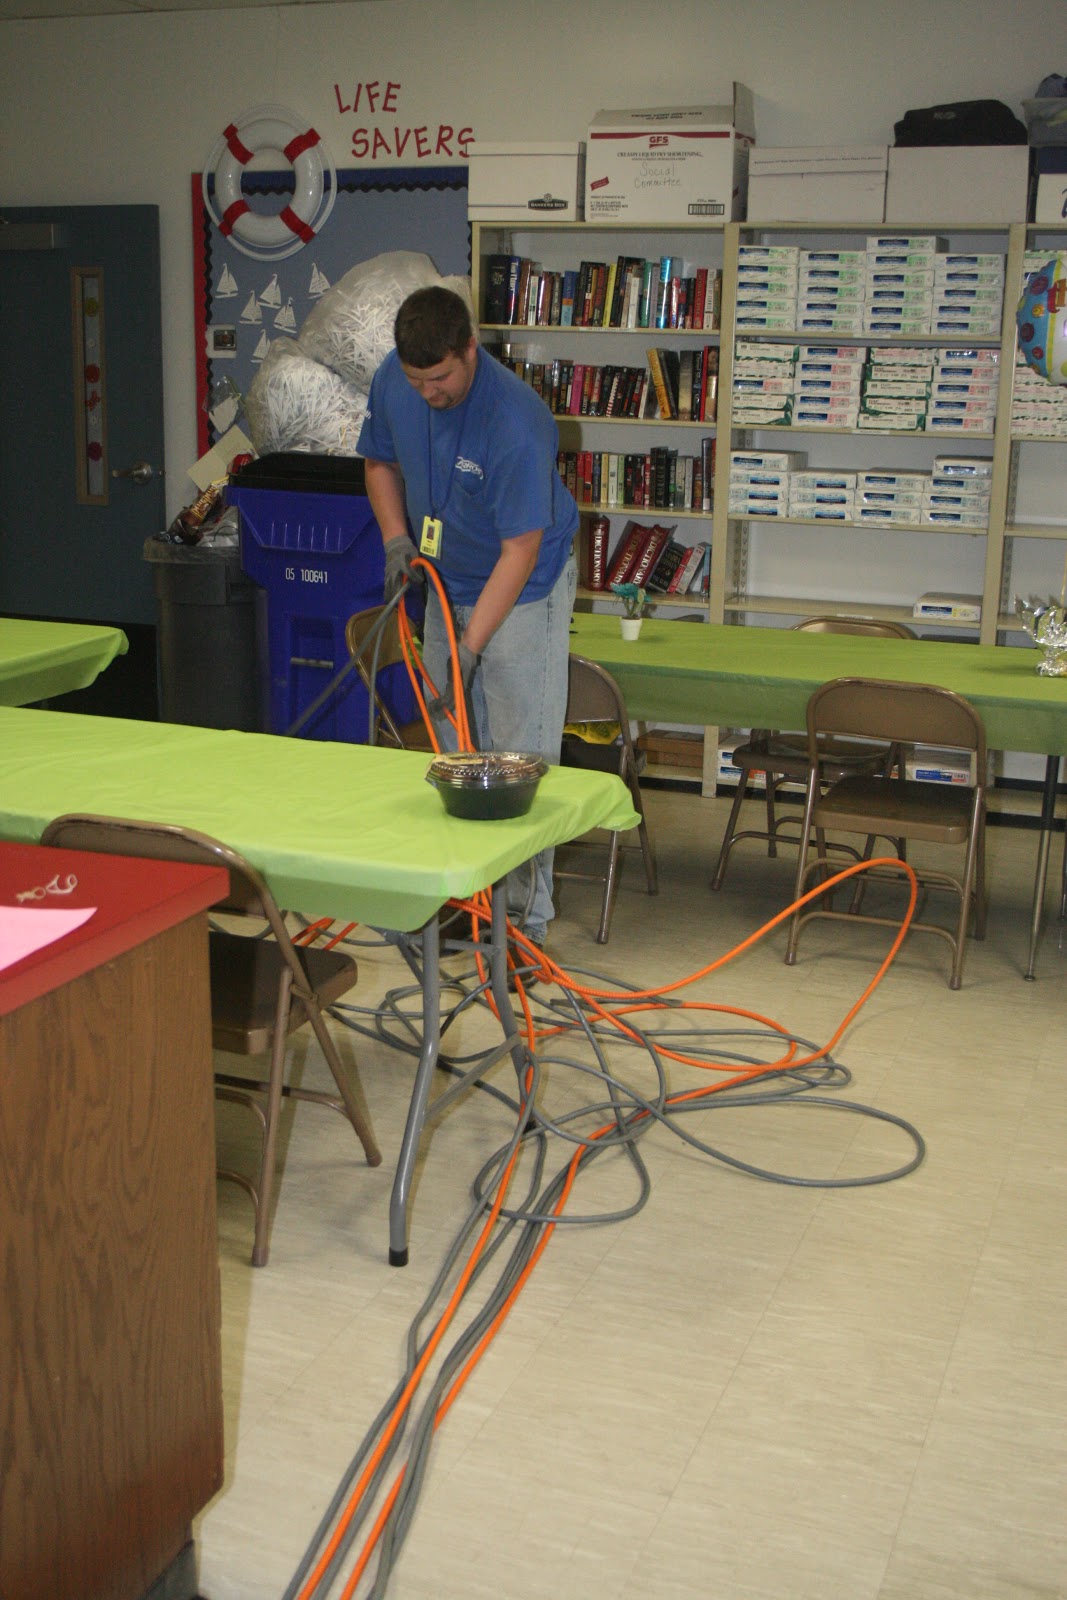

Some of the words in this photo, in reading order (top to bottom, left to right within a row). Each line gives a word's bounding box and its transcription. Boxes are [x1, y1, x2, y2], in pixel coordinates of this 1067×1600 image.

[334, 81, 401, 113] LIFE
[351, 124, 475, 159] SAVERS
[649, 136, 669, 144] GFS
[639, 161, 675, 177] Social
[634, 178, 681, 190] Committee
[593, 535, 603, 582] DICTIONARY
[285, 567, 295, 581] 05
[300, 568, 328, 584] 100641
